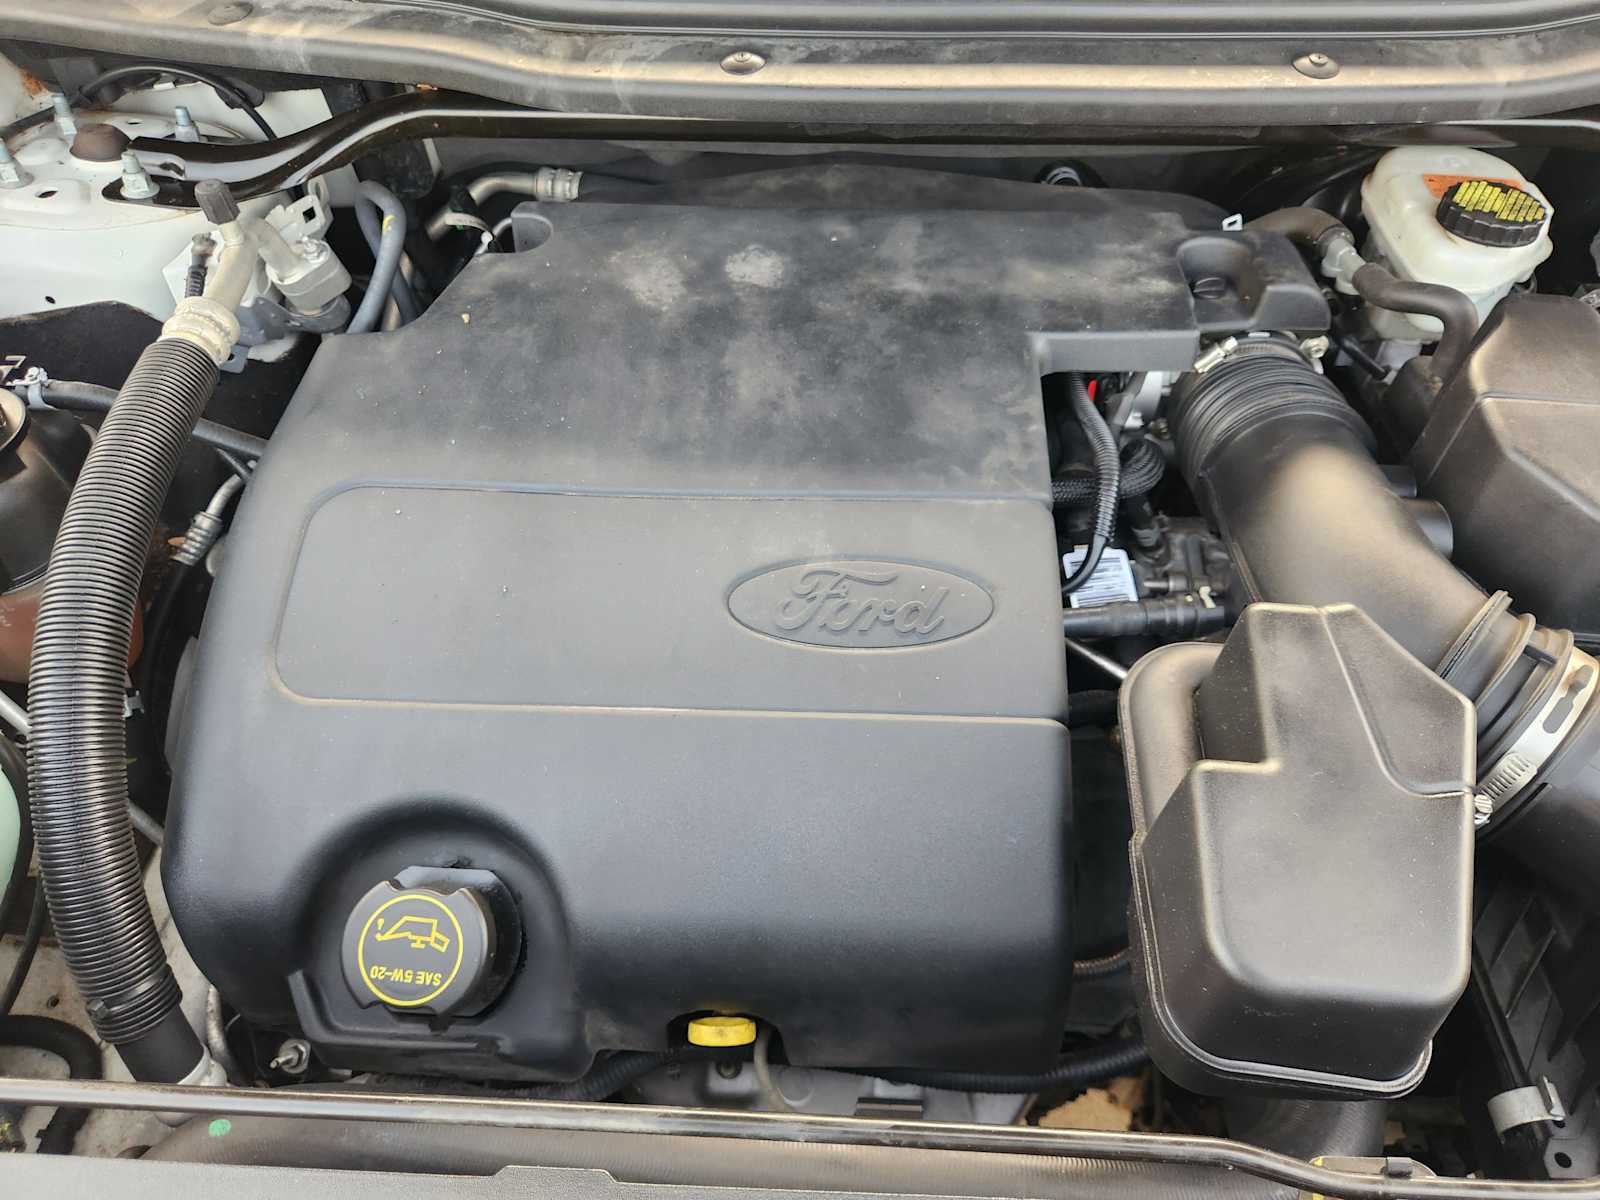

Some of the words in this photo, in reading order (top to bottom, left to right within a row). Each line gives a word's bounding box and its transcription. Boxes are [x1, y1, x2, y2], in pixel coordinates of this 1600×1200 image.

[775, 570, 947, 635] Ford
[370, 965, 414, 983] 5W-20
[415, 970, 442, 986] SAE
